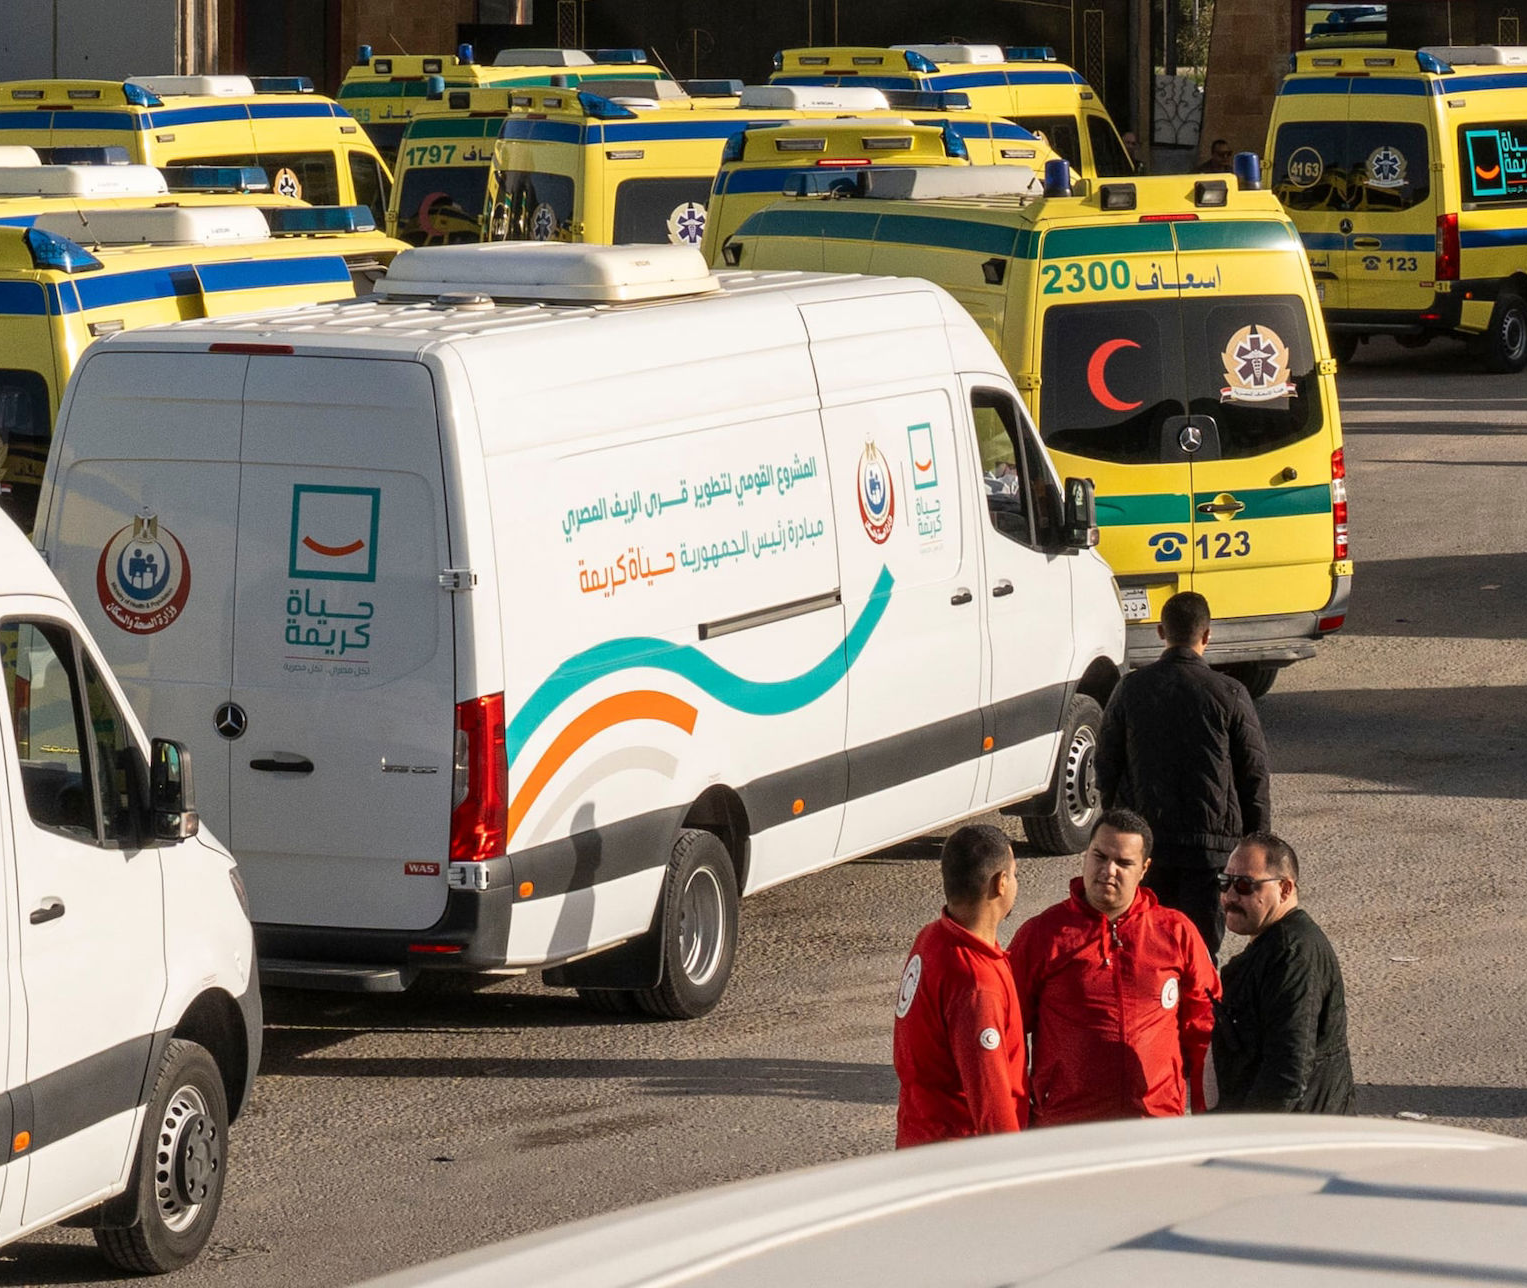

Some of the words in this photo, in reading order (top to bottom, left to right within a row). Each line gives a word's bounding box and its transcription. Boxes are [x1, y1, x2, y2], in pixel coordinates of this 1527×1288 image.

[406, 145, 456, 166] 1797
[1291, 162, 1319, 177] 4163
[1042, 260, 1131, 295] 2300
[1387, 257, 1418, 272] 123
[694, 472, 732, 508] لتطوير
[735, 464, 774, 506] القومي
[777, 453, 817, 495] المشروع
[610, 490, 642, 524] الريف
[644, 479, 688, 518] قرى
[562, 497, 608, 543] المصري
[788, 517, 824, 548] مبادرة
[680, 529, 750, 573] الجمهورية
[752, 520, 786, 558] رئيس
[1196, 531, 1250, 560] 123
[579, 554, 627, 598] كريمة
[628, 546, 676, 586] حياة
[287, 588, 374, 625] حياة
[285, 619, 370, 655] كريمة
